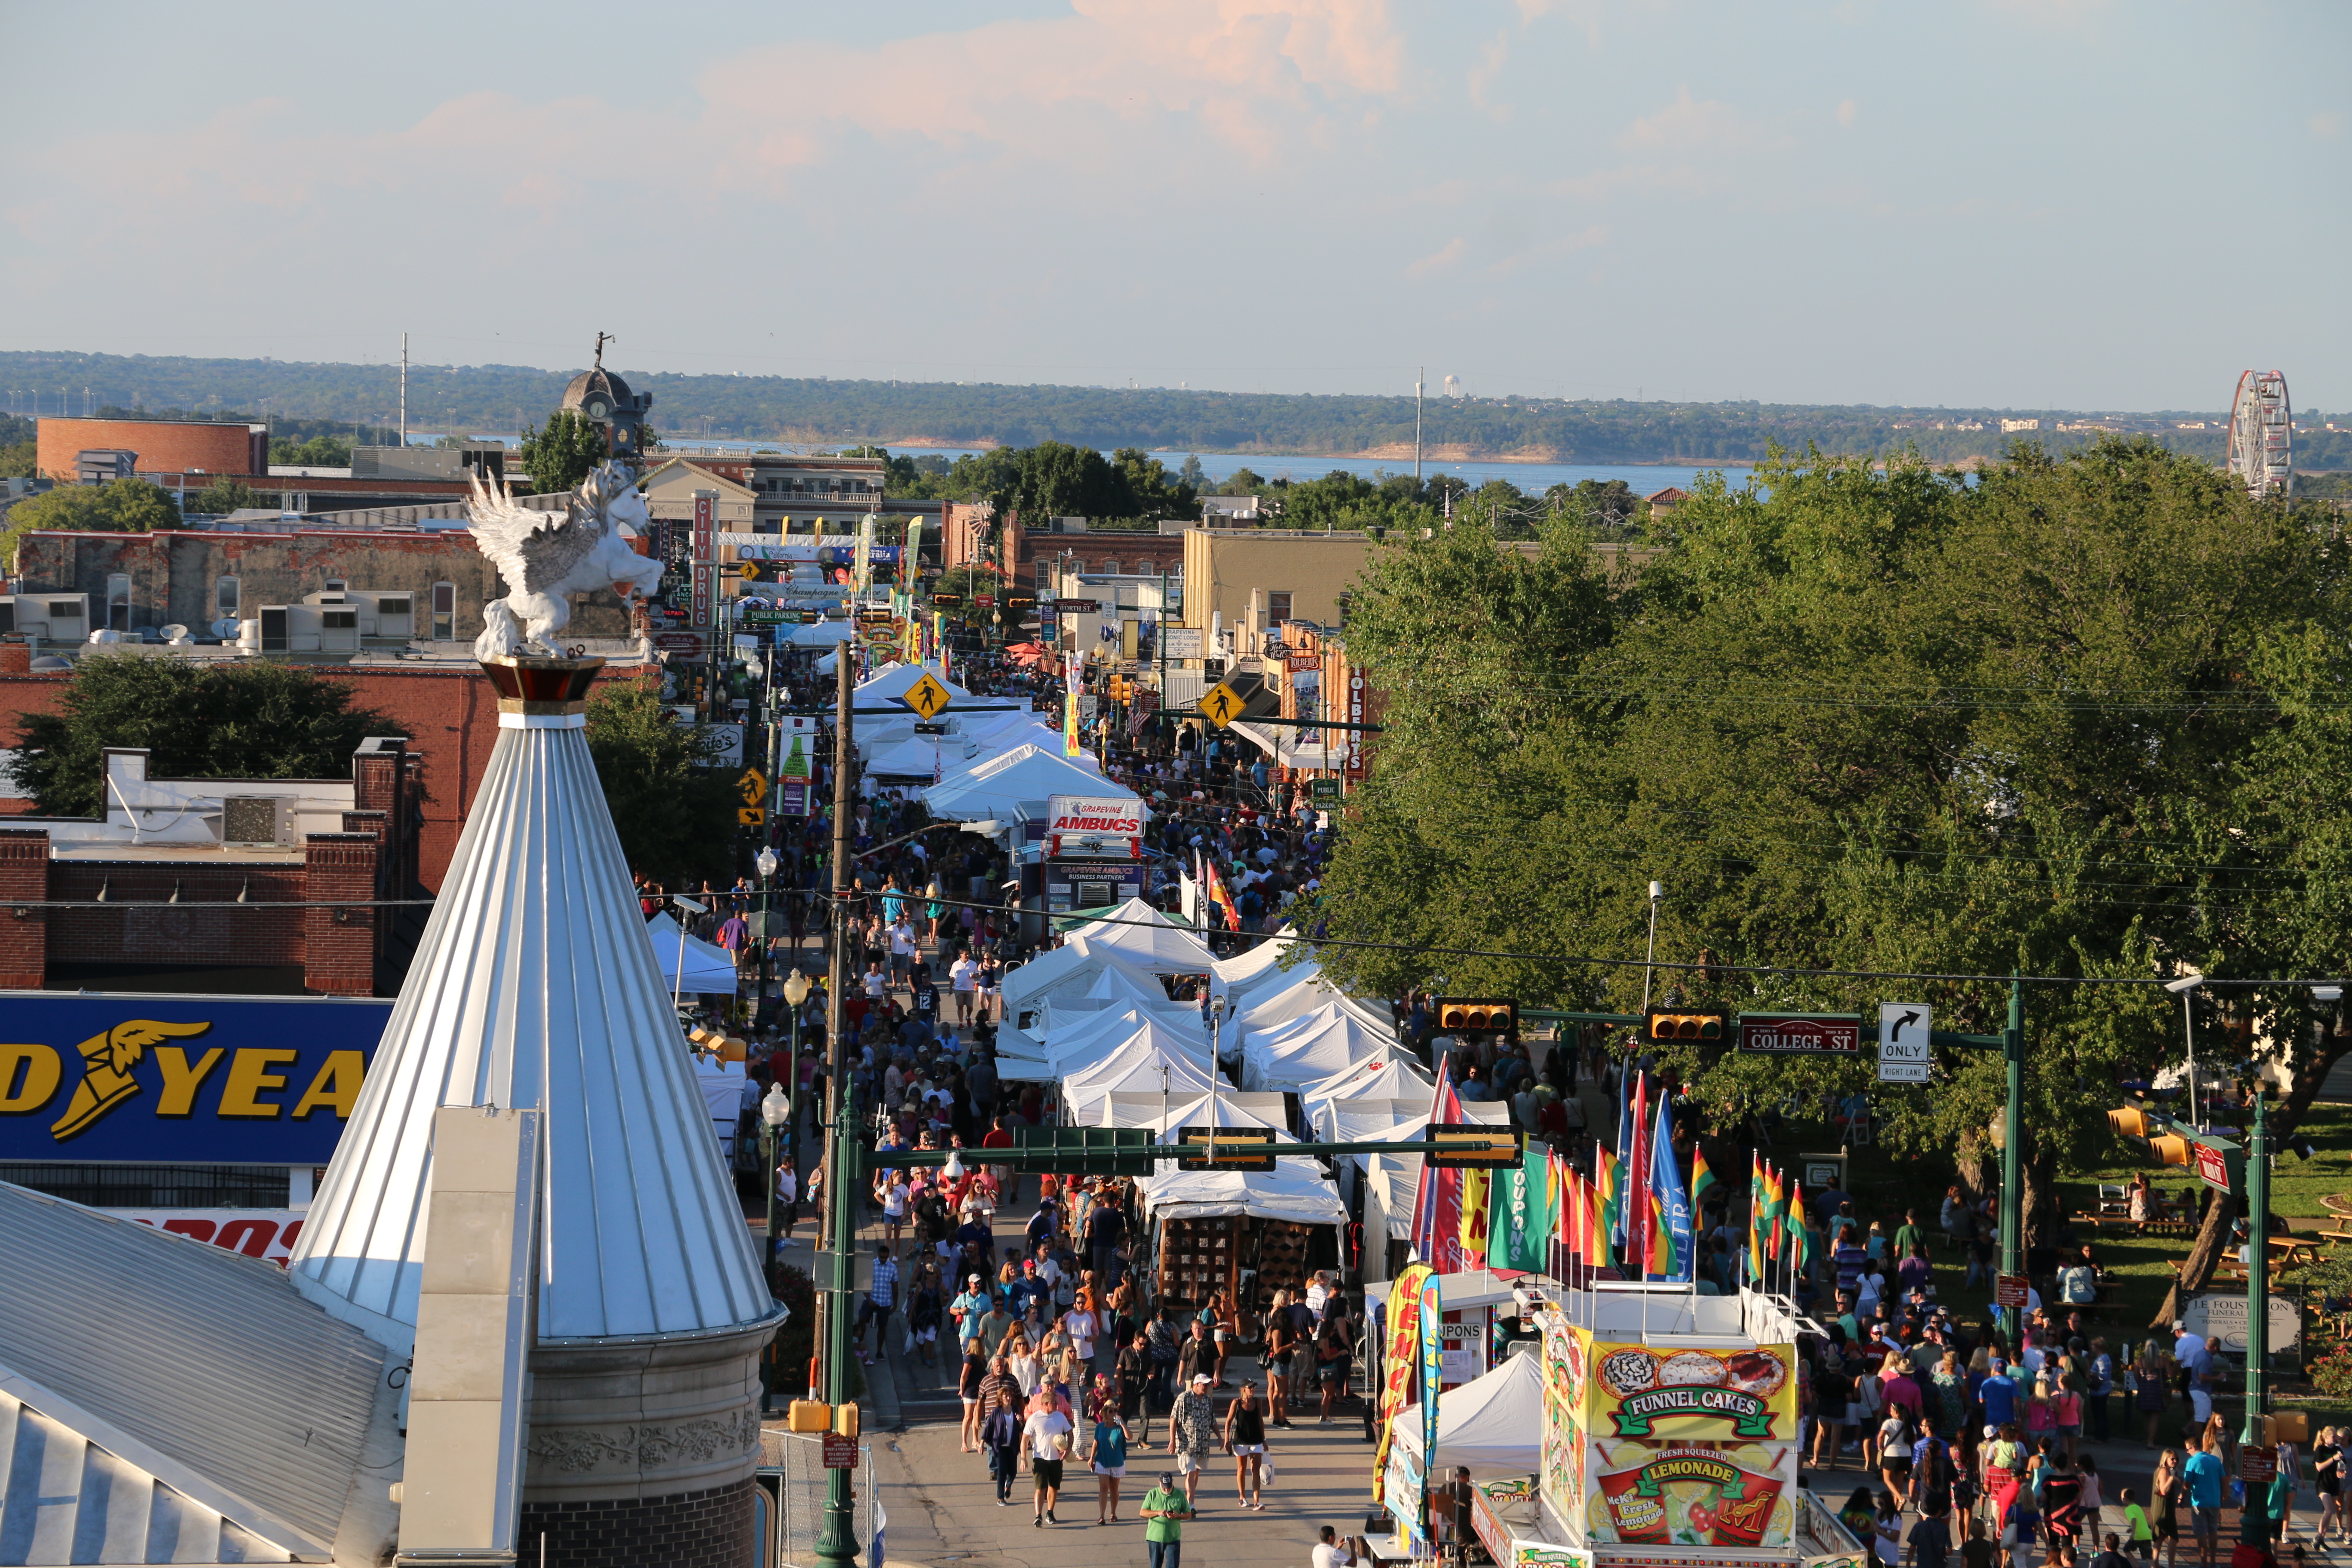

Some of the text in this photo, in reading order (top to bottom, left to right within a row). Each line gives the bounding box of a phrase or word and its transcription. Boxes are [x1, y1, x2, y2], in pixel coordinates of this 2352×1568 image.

[696, 500, 707, 625] CITY DRUG
[1081, 805, 1122, 814] GRAPEVINE
[1054, 816, 1139, 832] AMBUCS
[1102, 867, 1133, 875] AMBUCS
[919, 995, 931, 1009] 12
[1752, 1035, 1851, 1050] COLLEGE ST
[1886, 1045, 1921, 1057] ONLY
[2193, 1300, 2209, 1310] J.E.
[2229, 1335, 2248, 1345] Dignit
[1631, 1391, 1757, 1415] FUNNEL CAKES
[1657, 1448, 1727, 1461] FRESH SQUEEZED
[1649, 1461, 1734, 1482] LEMONADE
[1621, 1500, 1655, 1515] Fresh
[1615, 1508, 1664, 1527] Lemonade
[1548, 1553, 1571, 1562] SQUEEZED
